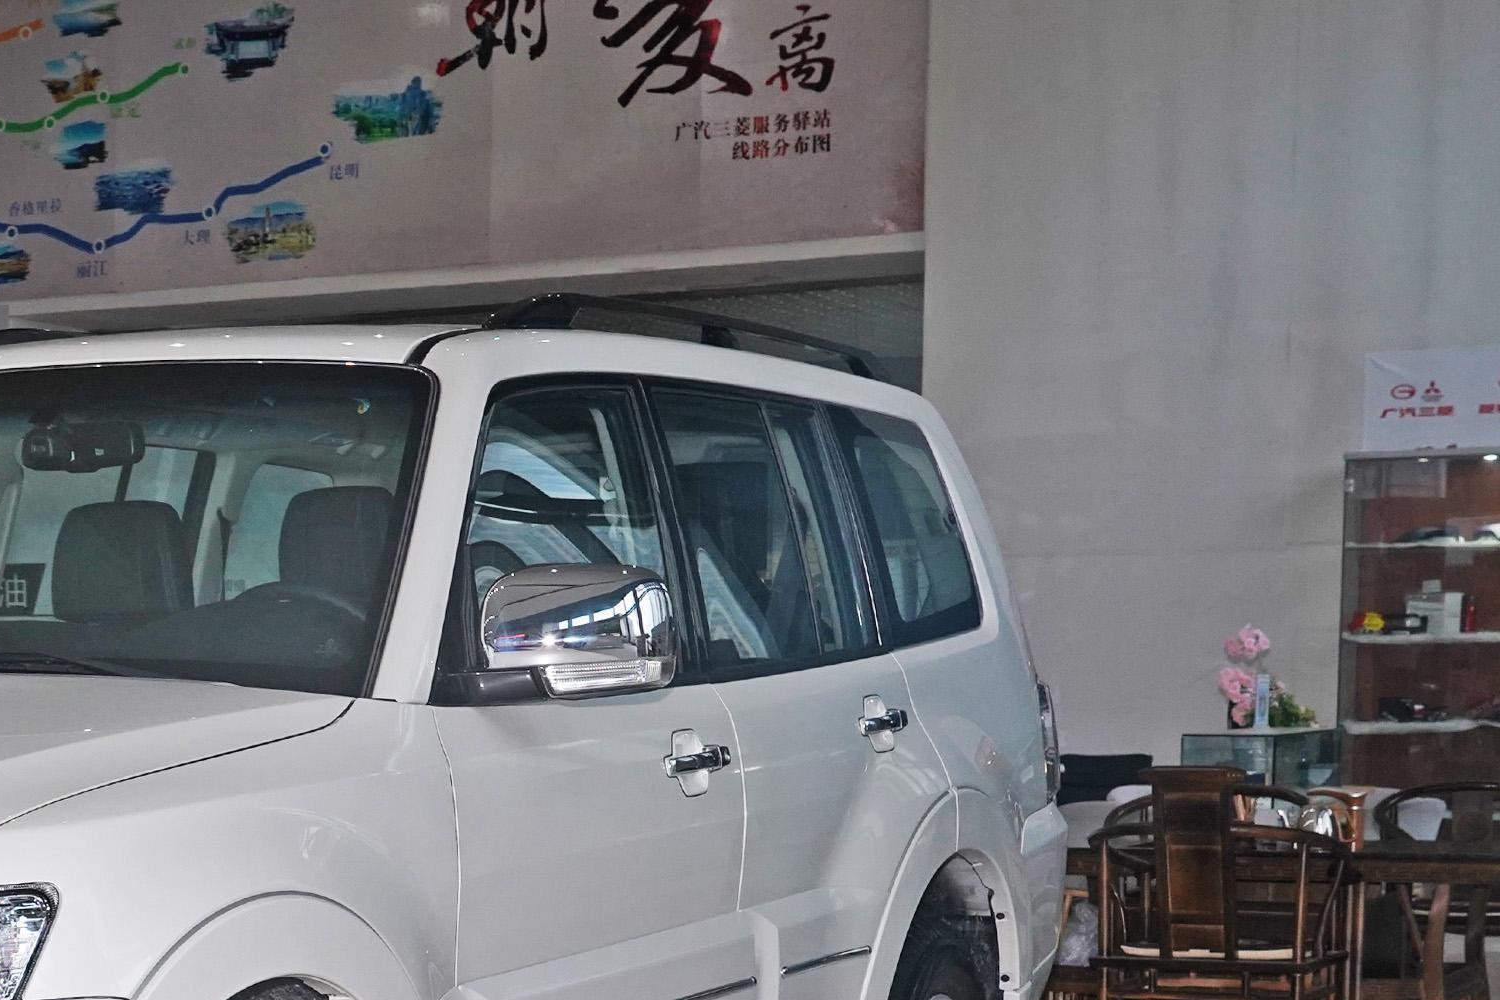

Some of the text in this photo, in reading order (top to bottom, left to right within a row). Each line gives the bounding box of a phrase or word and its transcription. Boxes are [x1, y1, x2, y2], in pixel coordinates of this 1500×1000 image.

[674, 109, 832, 143] 广汽三菱服务驿站
[731, 132, 832, 160] 线路分布图
[328, 163, 360, 180] 昆明
[8, 199, 62, 217] 香格里拉
[182, 228, 211, 246] 大理
[74, 261, 108, 279] 丽江
